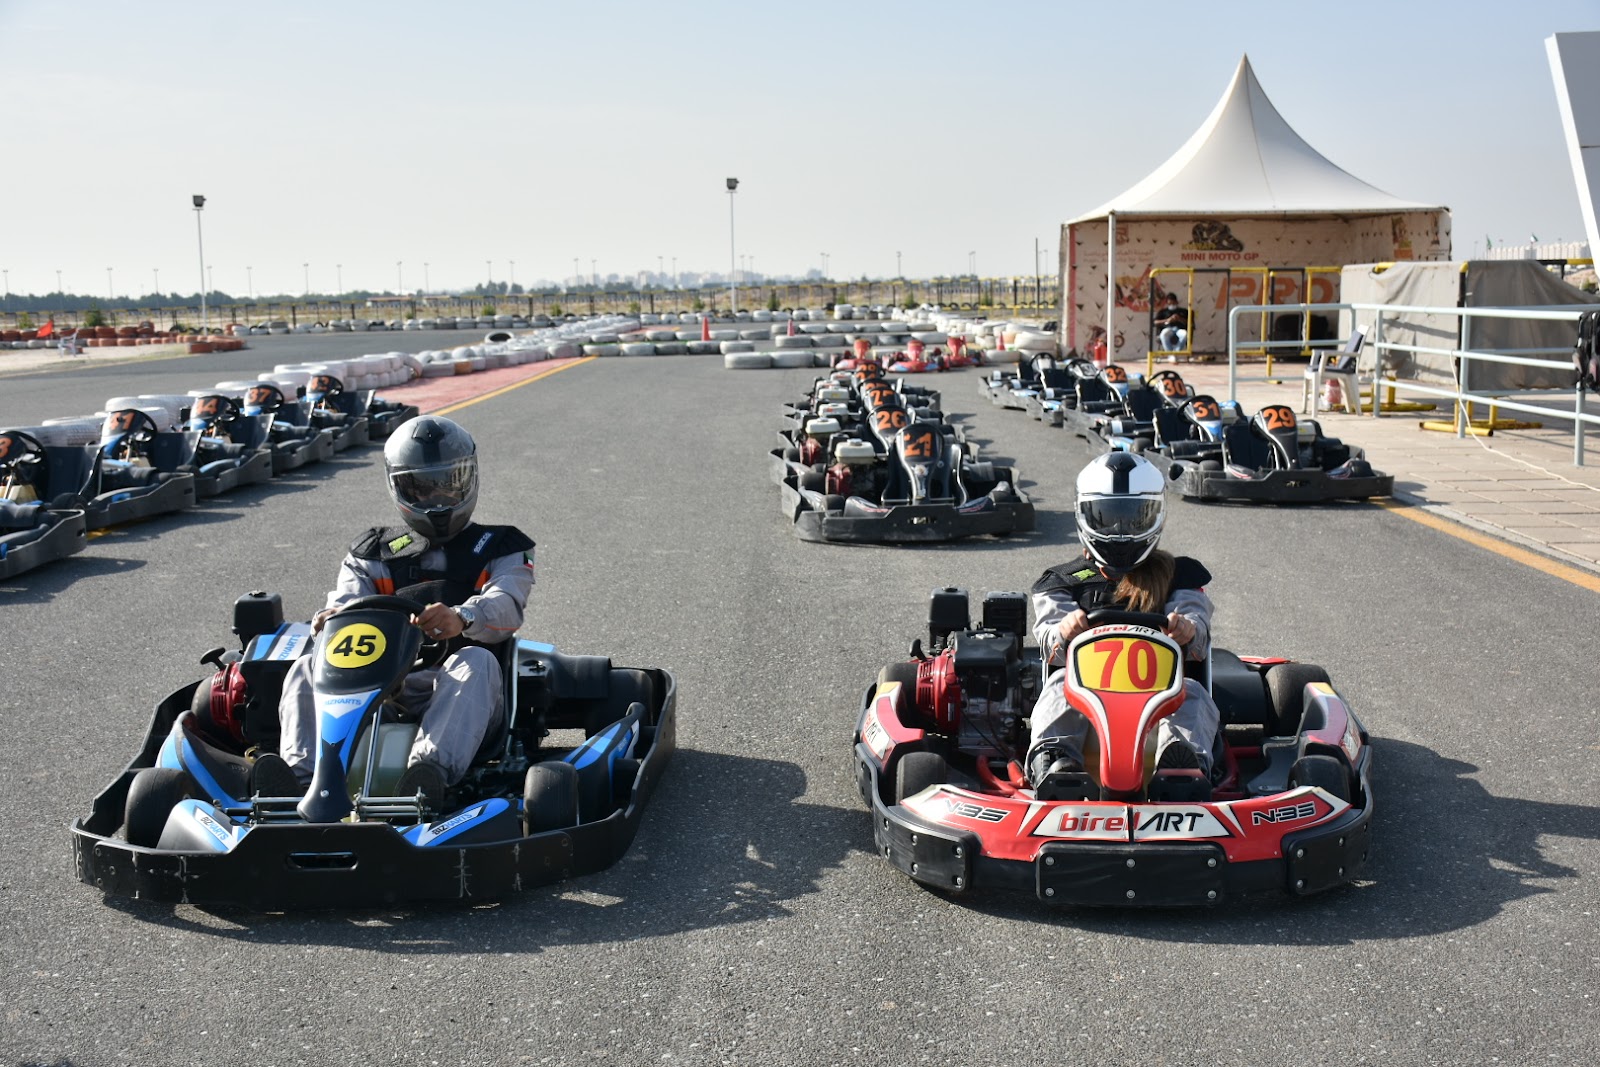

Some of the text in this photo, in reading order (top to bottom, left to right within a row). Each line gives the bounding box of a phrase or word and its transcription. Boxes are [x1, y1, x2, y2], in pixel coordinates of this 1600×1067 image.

[1181, 252, 1260, 261] MINI MOTO GP
[1105, 367, 1128, 383] 32
[1162, 378, 1188, 397] 30
[1192, 401, 1220, 419] 31
[1262, 407, 1296, 432] 29
[903, 431, 933, 457] 21
[332, 634, 377, 657] 45
[1093, 639, 1158, 690] 70
[431, 812, 474, 836] BIZKARTS
[1250, 800, 1317, 826] N-35
[200, 816, 229, 841] BIZKARTS
